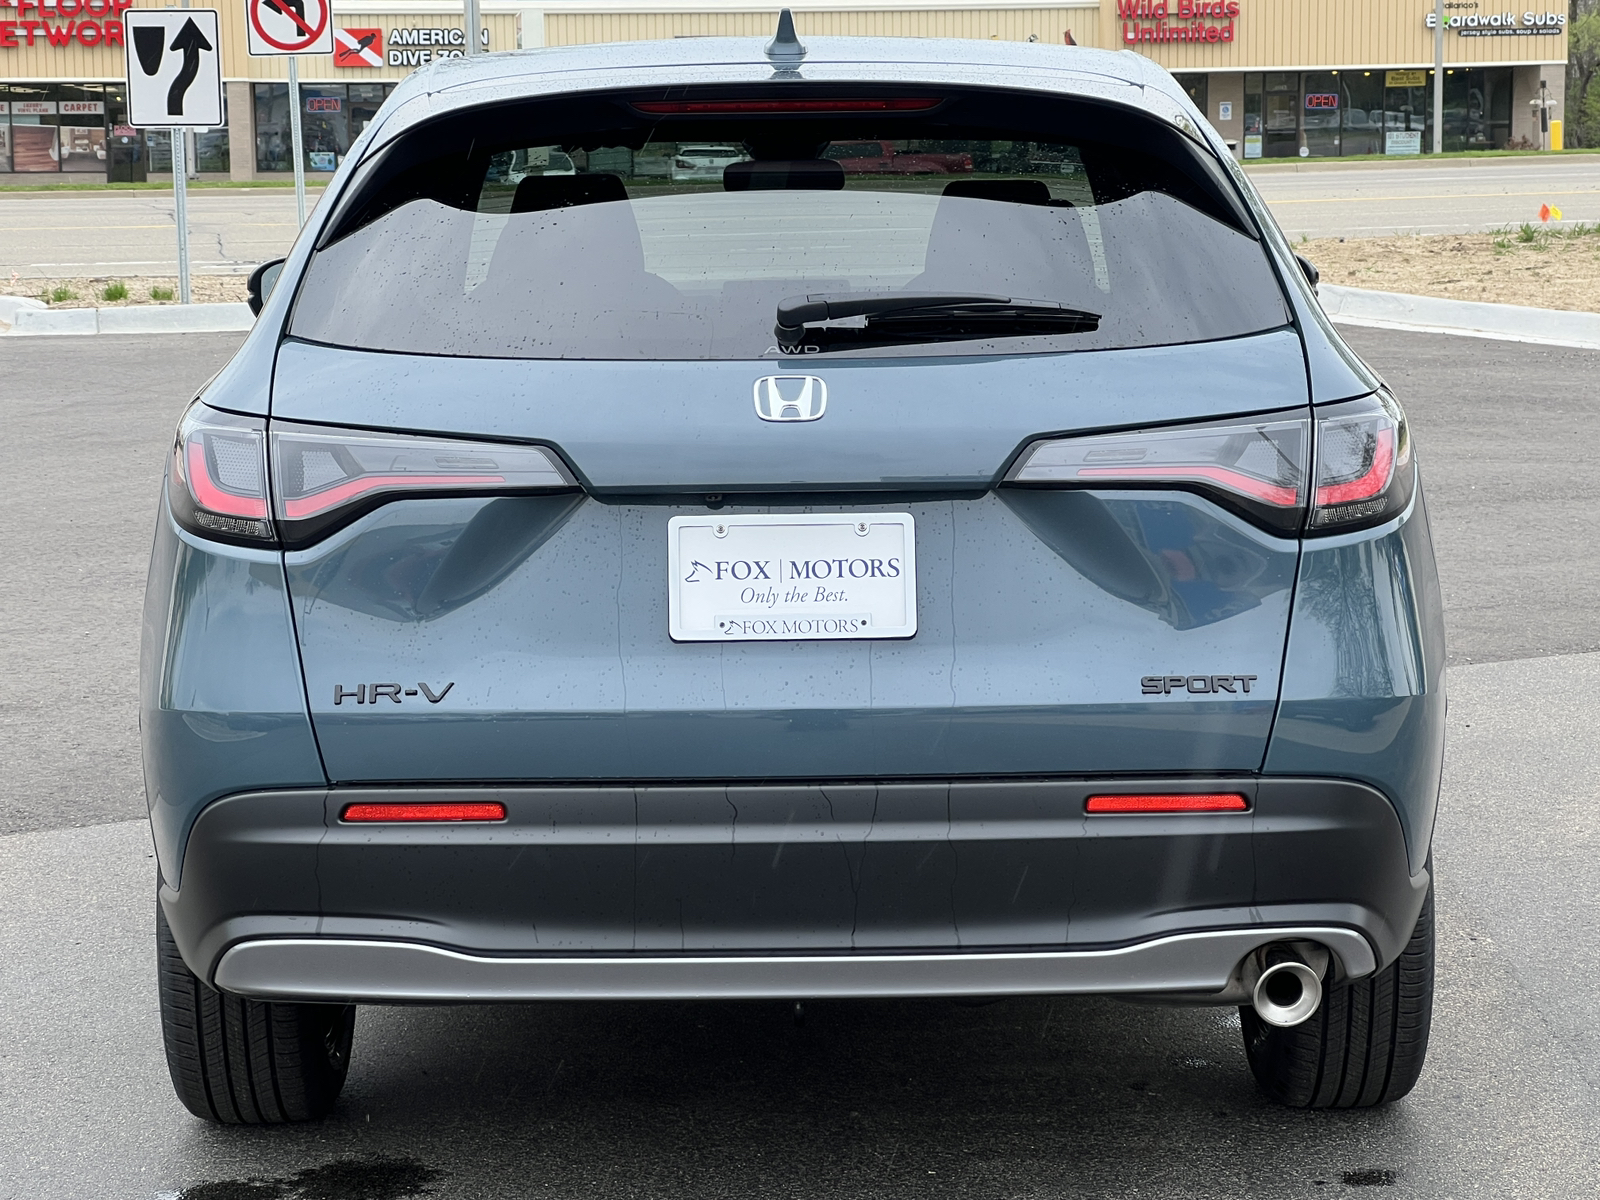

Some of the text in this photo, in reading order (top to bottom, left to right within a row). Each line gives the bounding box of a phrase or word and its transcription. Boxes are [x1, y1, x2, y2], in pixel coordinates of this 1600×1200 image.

[1118, 0, 1239, 19] Wild Birds
[1442, 1, 1478, 9] allarico's
[1522, 11, 1566, 26] Subs
[1123, 20, 1235, 44] Unlimited
[388, 49, 432, 66] DIVE
[64, 103, 98, 112] CARPET
[308, 99, 340, 111] OPEN
[1307, 95, 1337, 108] OPEN
[764, 345, 820, 354] AWD
[714, 557, 900, 580] FOX MOTORS
[740, 586, 849, 609] Only the Best.
[742, 618, 859, 635] FOX MOTORS
[1141, 675, 1257, 694] SPORT
[334, 682, 455, 705] HR-V
